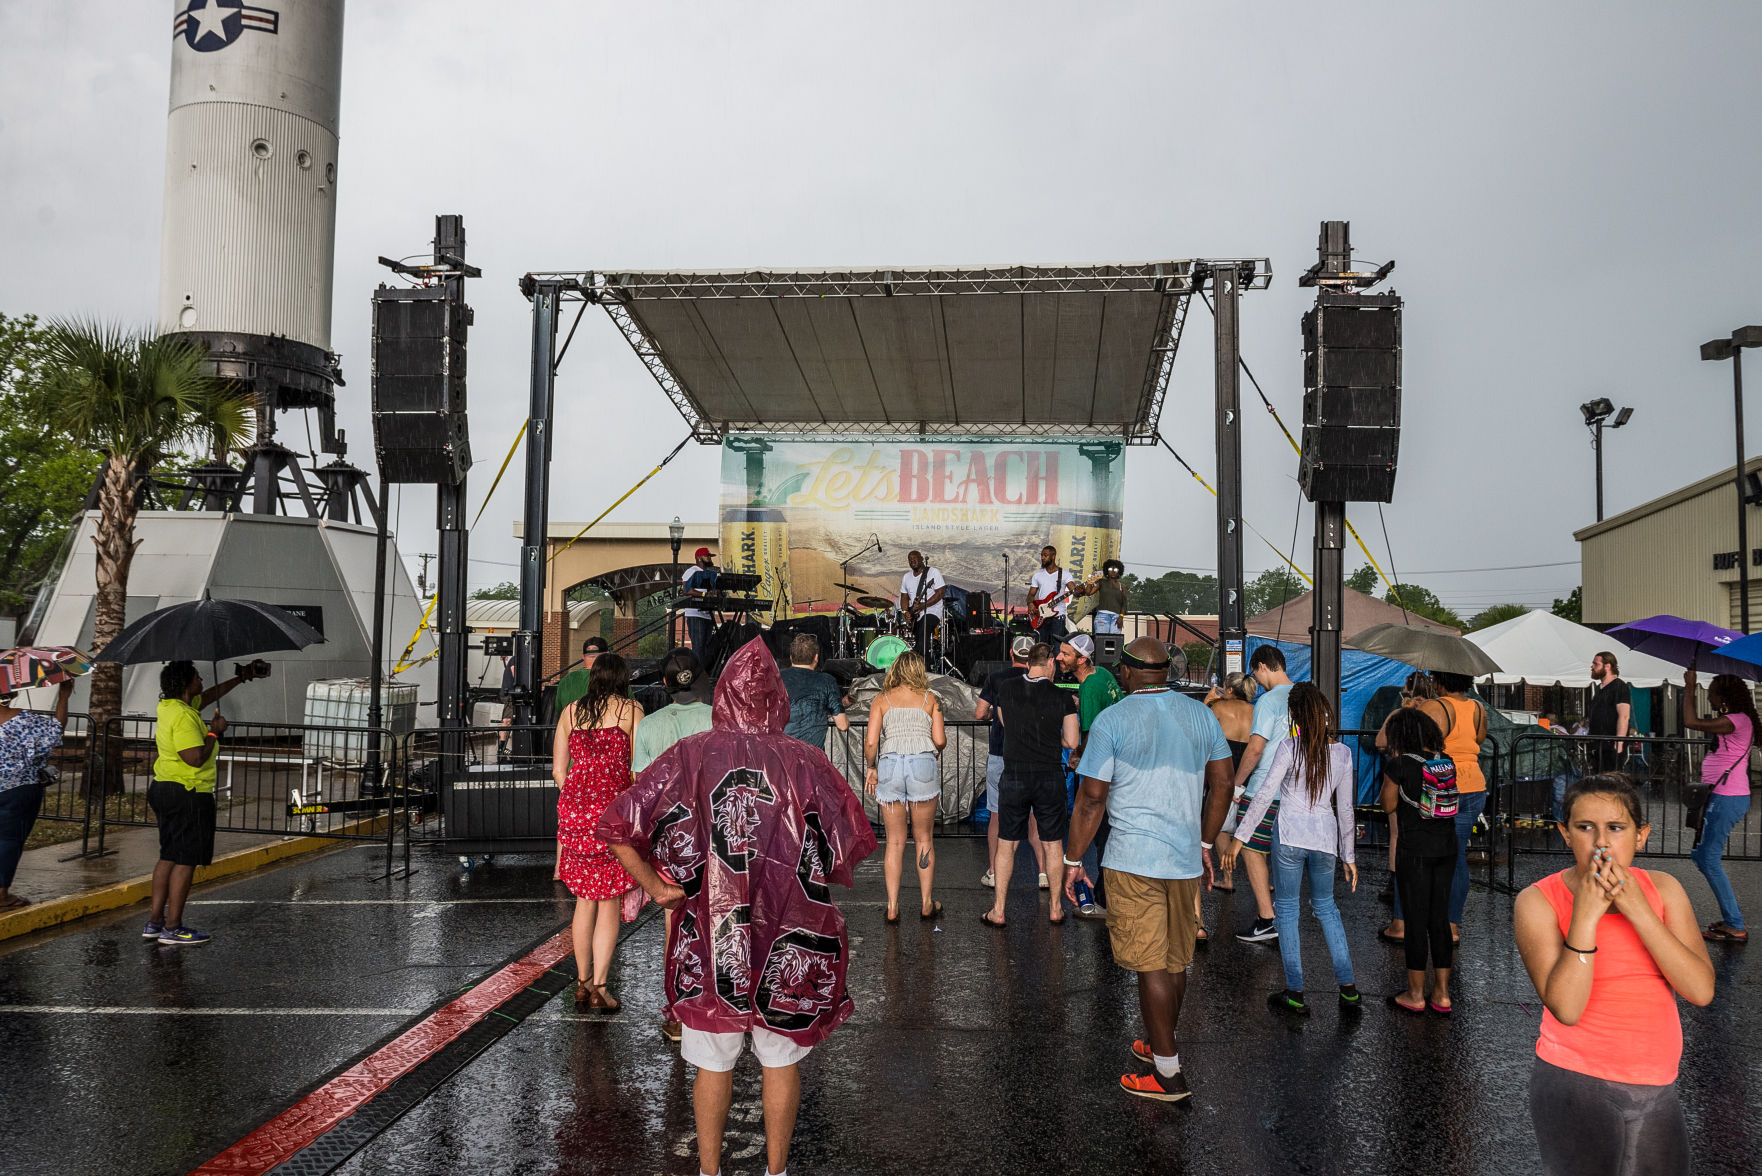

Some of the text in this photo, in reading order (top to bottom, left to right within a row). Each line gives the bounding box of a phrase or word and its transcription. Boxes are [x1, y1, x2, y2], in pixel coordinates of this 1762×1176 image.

[791, 447, 1060, 511] Let's BEACH
[911, 506, 1000, 523] LANDSHARK
